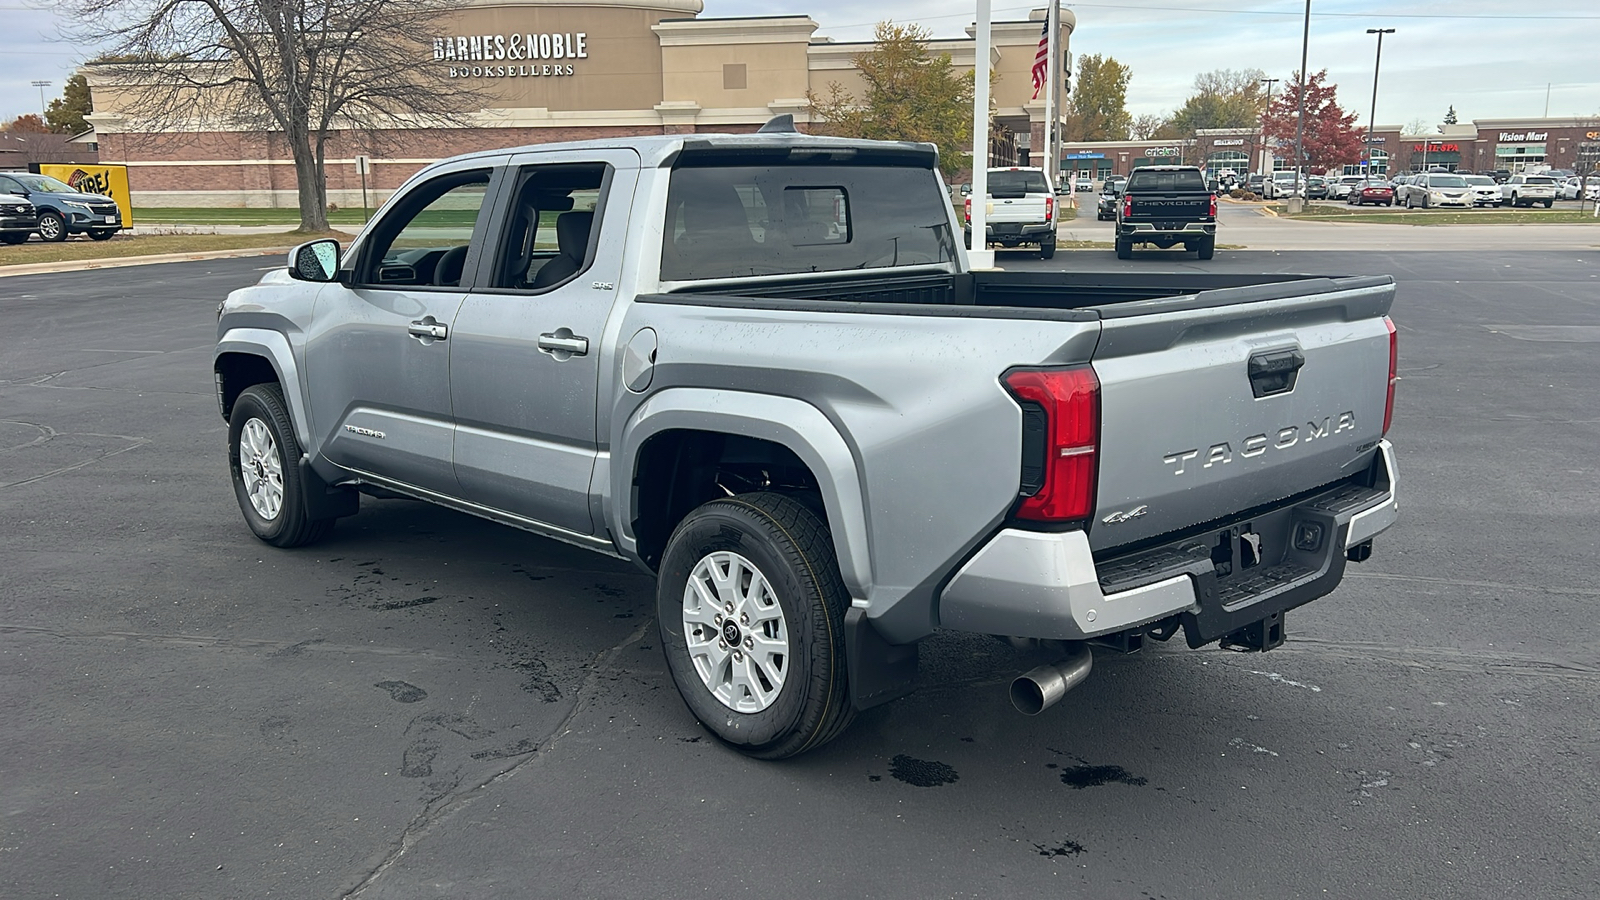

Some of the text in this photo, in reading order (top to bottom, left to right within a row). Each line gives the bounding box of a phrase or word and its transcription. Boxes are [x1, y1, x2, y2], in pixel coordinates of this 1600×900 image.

[449, 64, 575, 79] BOOKSELLERS
[1499, 131, 1548, 142] Vision Mart
[1144, 146, 1180, 157] cricket
[1440, 143, 1459, 152] SPA
[74, 169, 109, 193] TIRES
[344, 424, 386, 439] TACOMA
[1163, 410, 1356, 475] TACOMA
